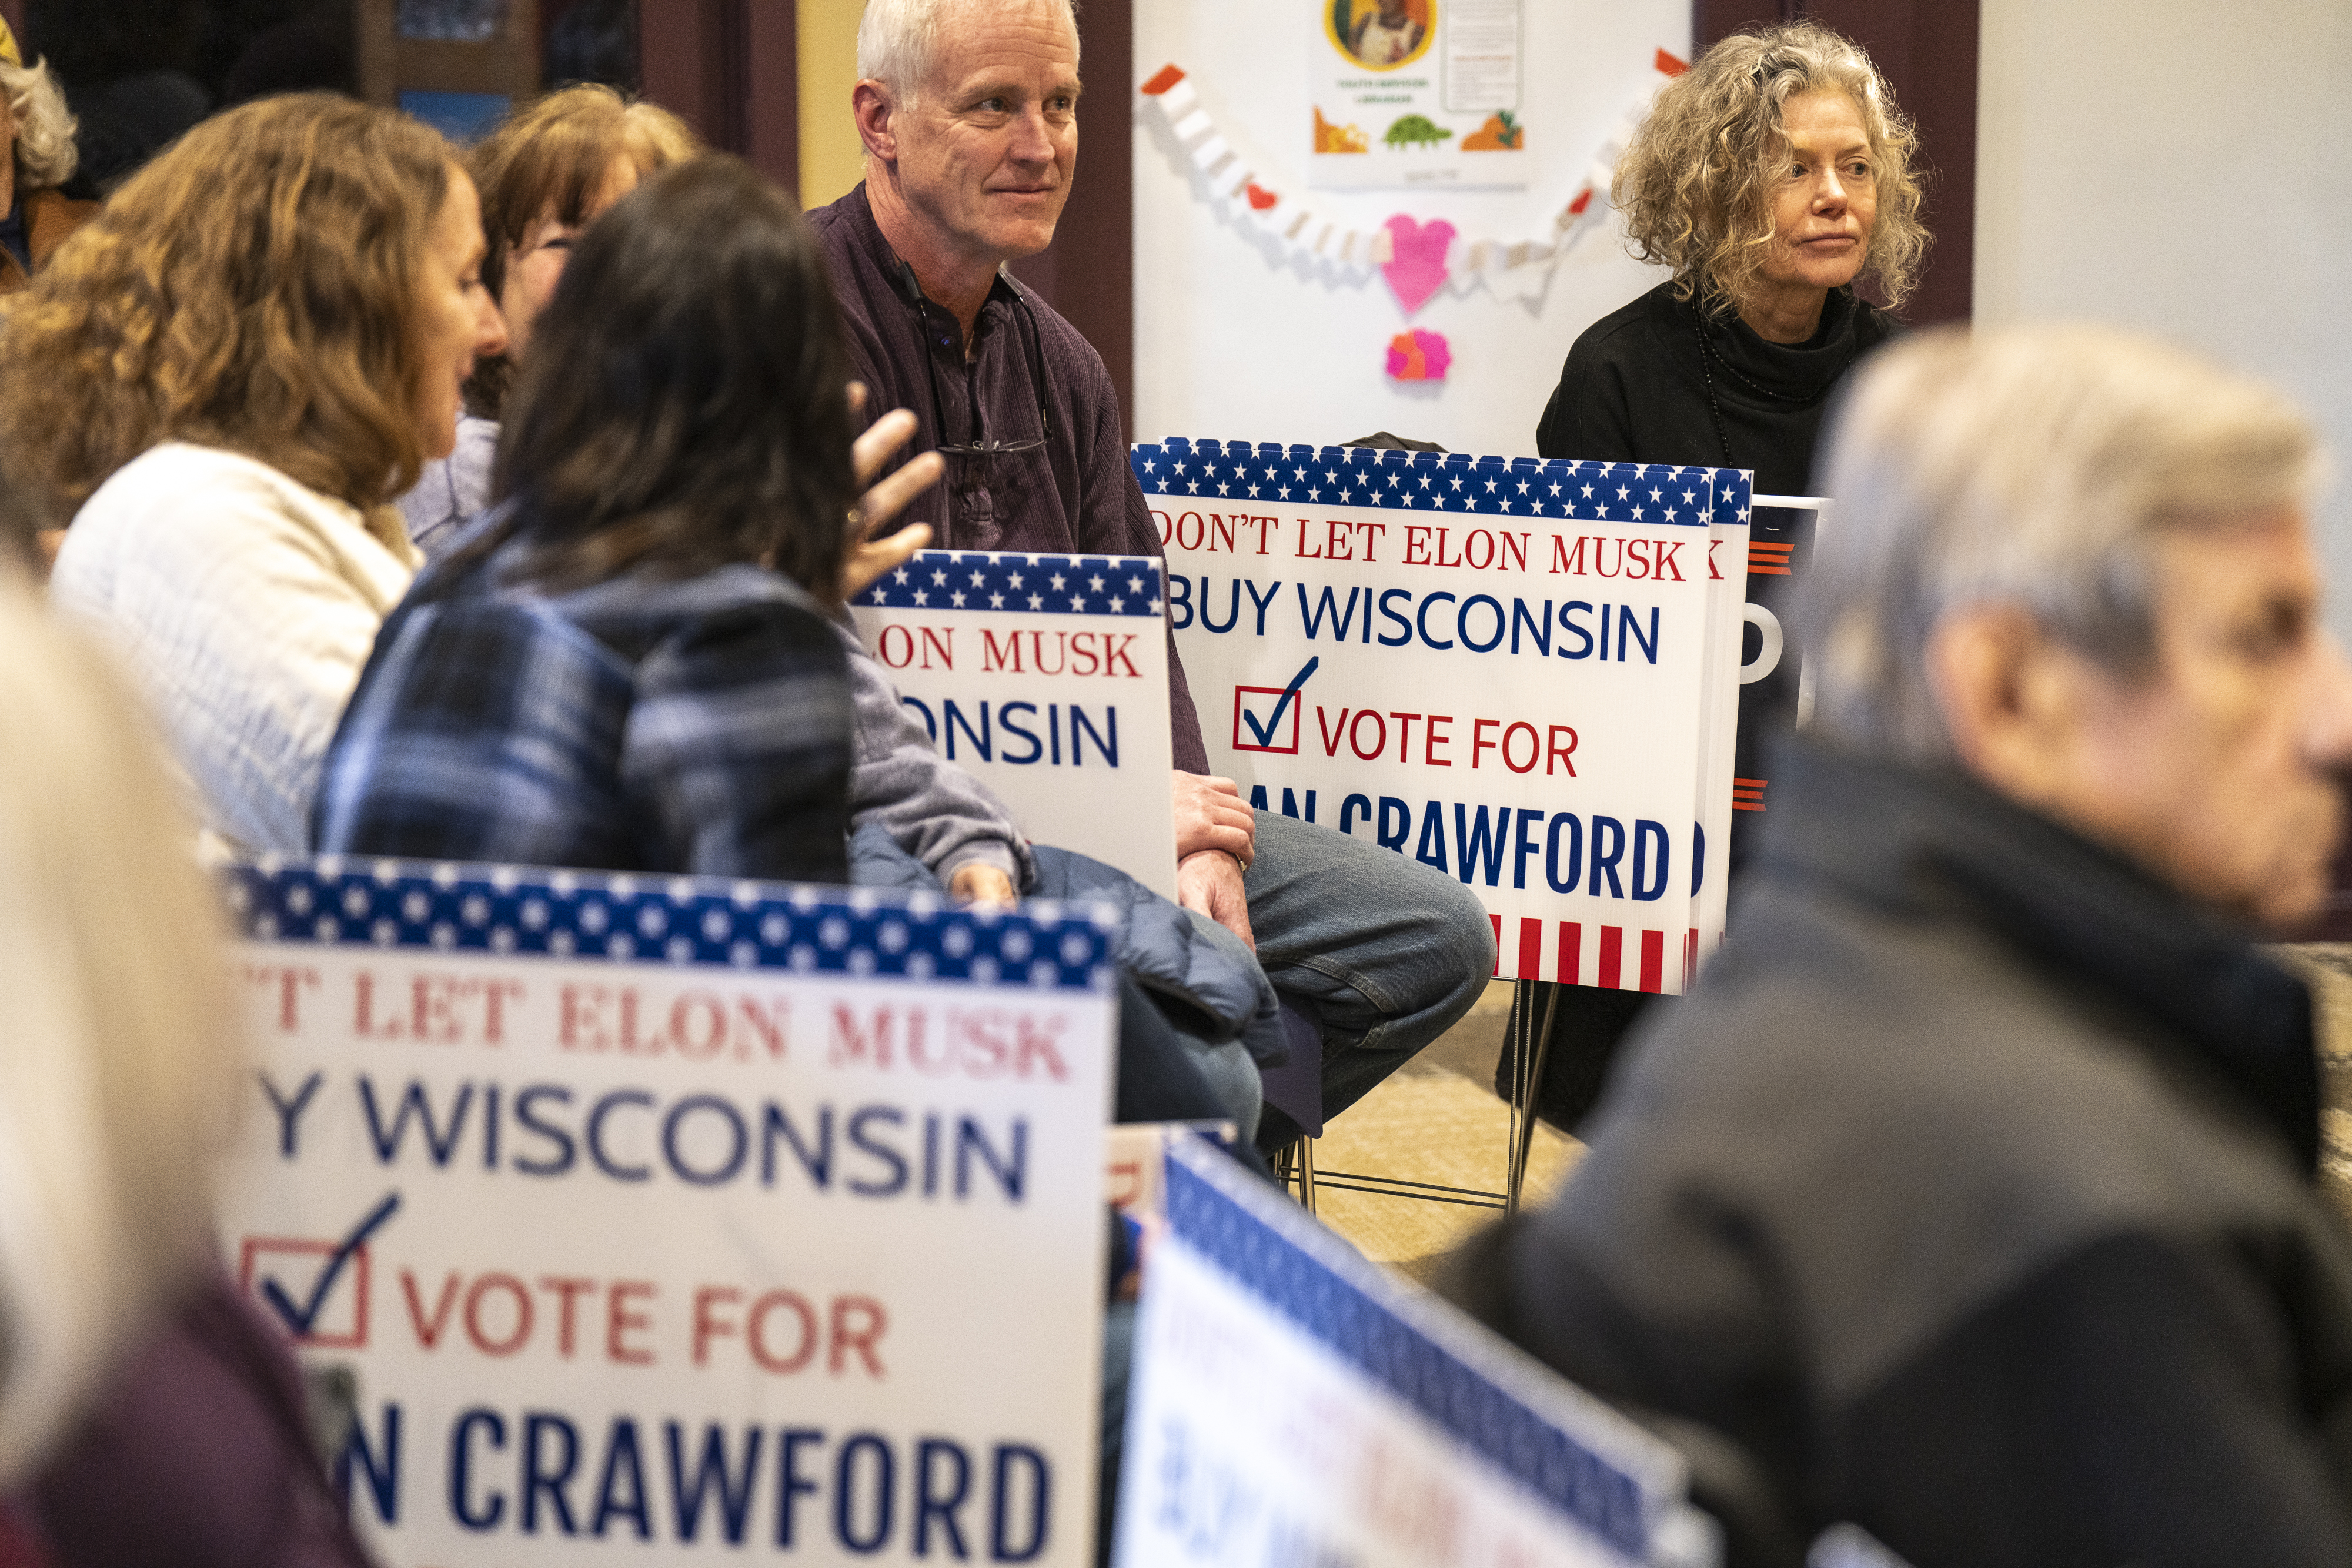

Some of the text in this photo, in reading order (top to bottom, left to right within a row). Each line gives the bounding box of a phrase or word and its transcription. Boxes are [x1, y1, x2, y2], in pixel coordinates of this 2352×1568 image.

[1149, 510, 1687, 583] DON'T LET ELON MUSK
[873, 624, 1143, 678] ON MUSK
[1168, 574, 1282, 636] BUY
[1297, 583, 1661, 665] WISCONSIN
[1315, 705, 1579, 778] VOTE FOR
[352, 970, 524, 1046] LET
[557, 982, 787, 1059] ELON
[828, 1001, 1071, 1083] MUSK
[355, 1072, 1030, 1204] WISCONSIN
[397, 1266, 890, 1379] VOTE FOR
[446, 1404, 1054, 1566] CRAWFORD
